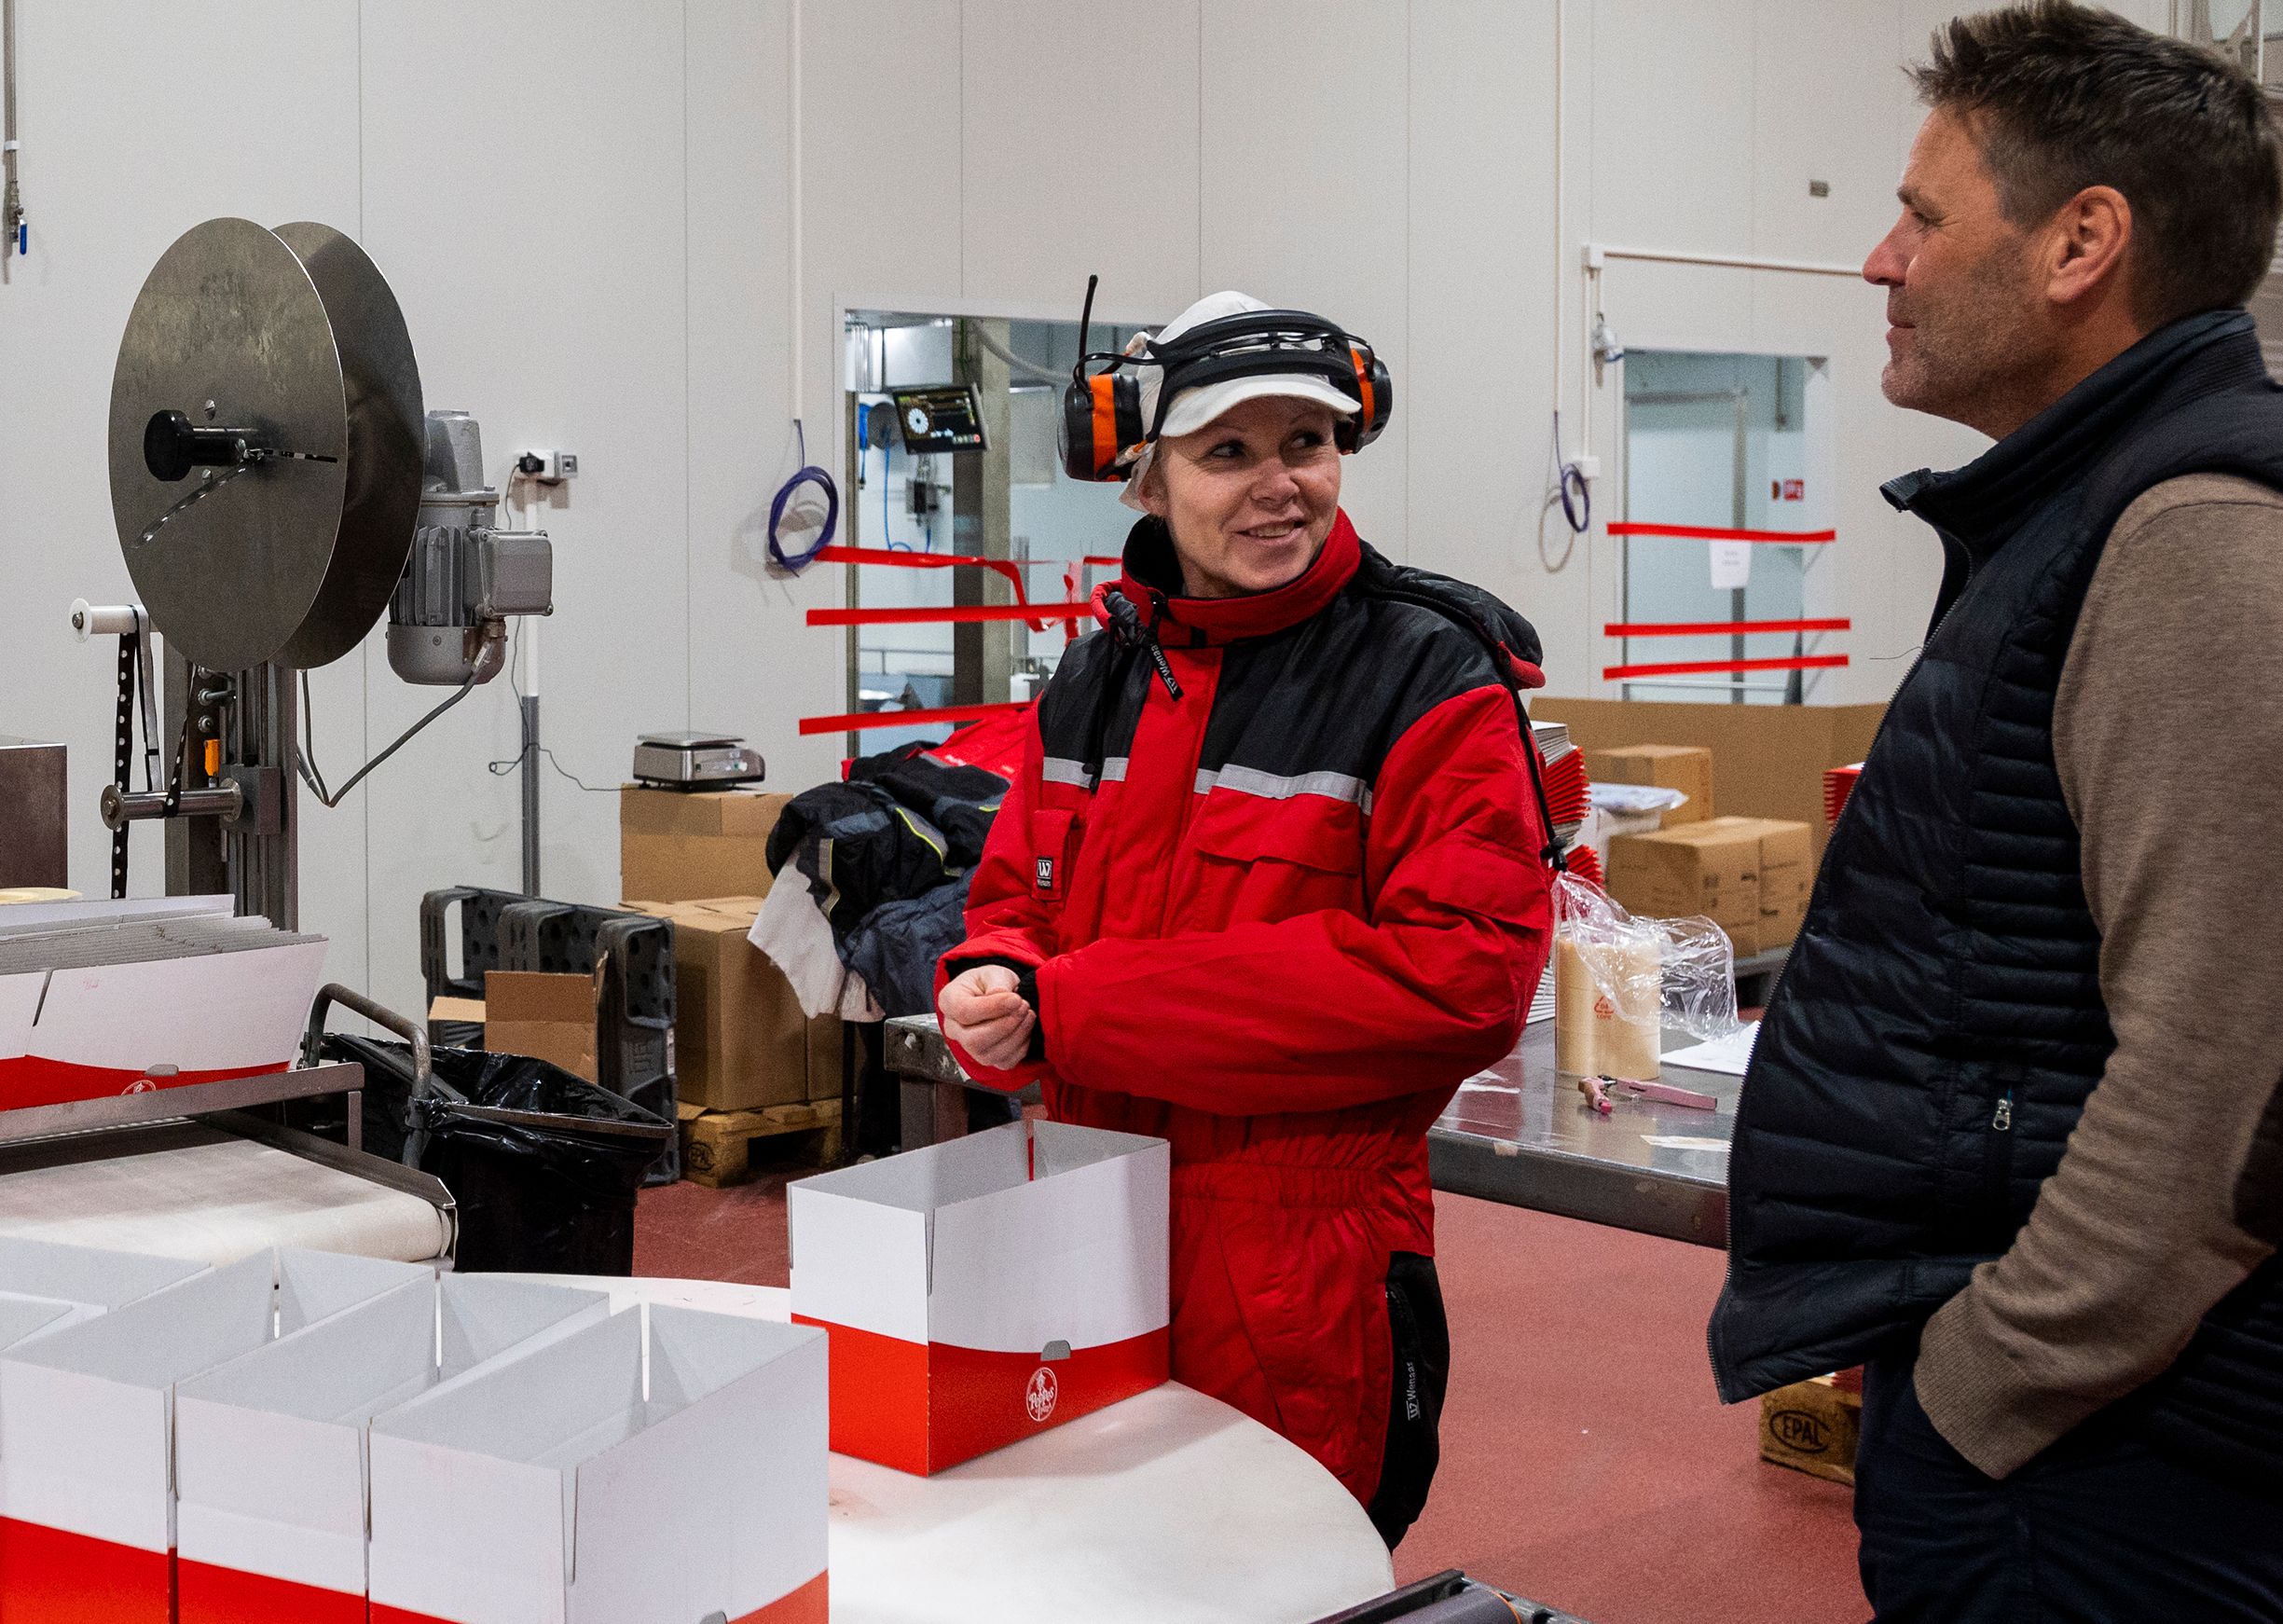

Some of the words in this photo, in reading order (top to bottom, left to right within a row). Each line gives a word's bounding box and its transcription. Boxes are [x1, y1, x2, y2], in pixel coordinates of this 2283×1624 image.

[1150, 643, 1171, 677] Wenaa
[1406, 1361, 1418, 1400] Wenaas
[1782, 1415, 1822, 1448] EPAL
